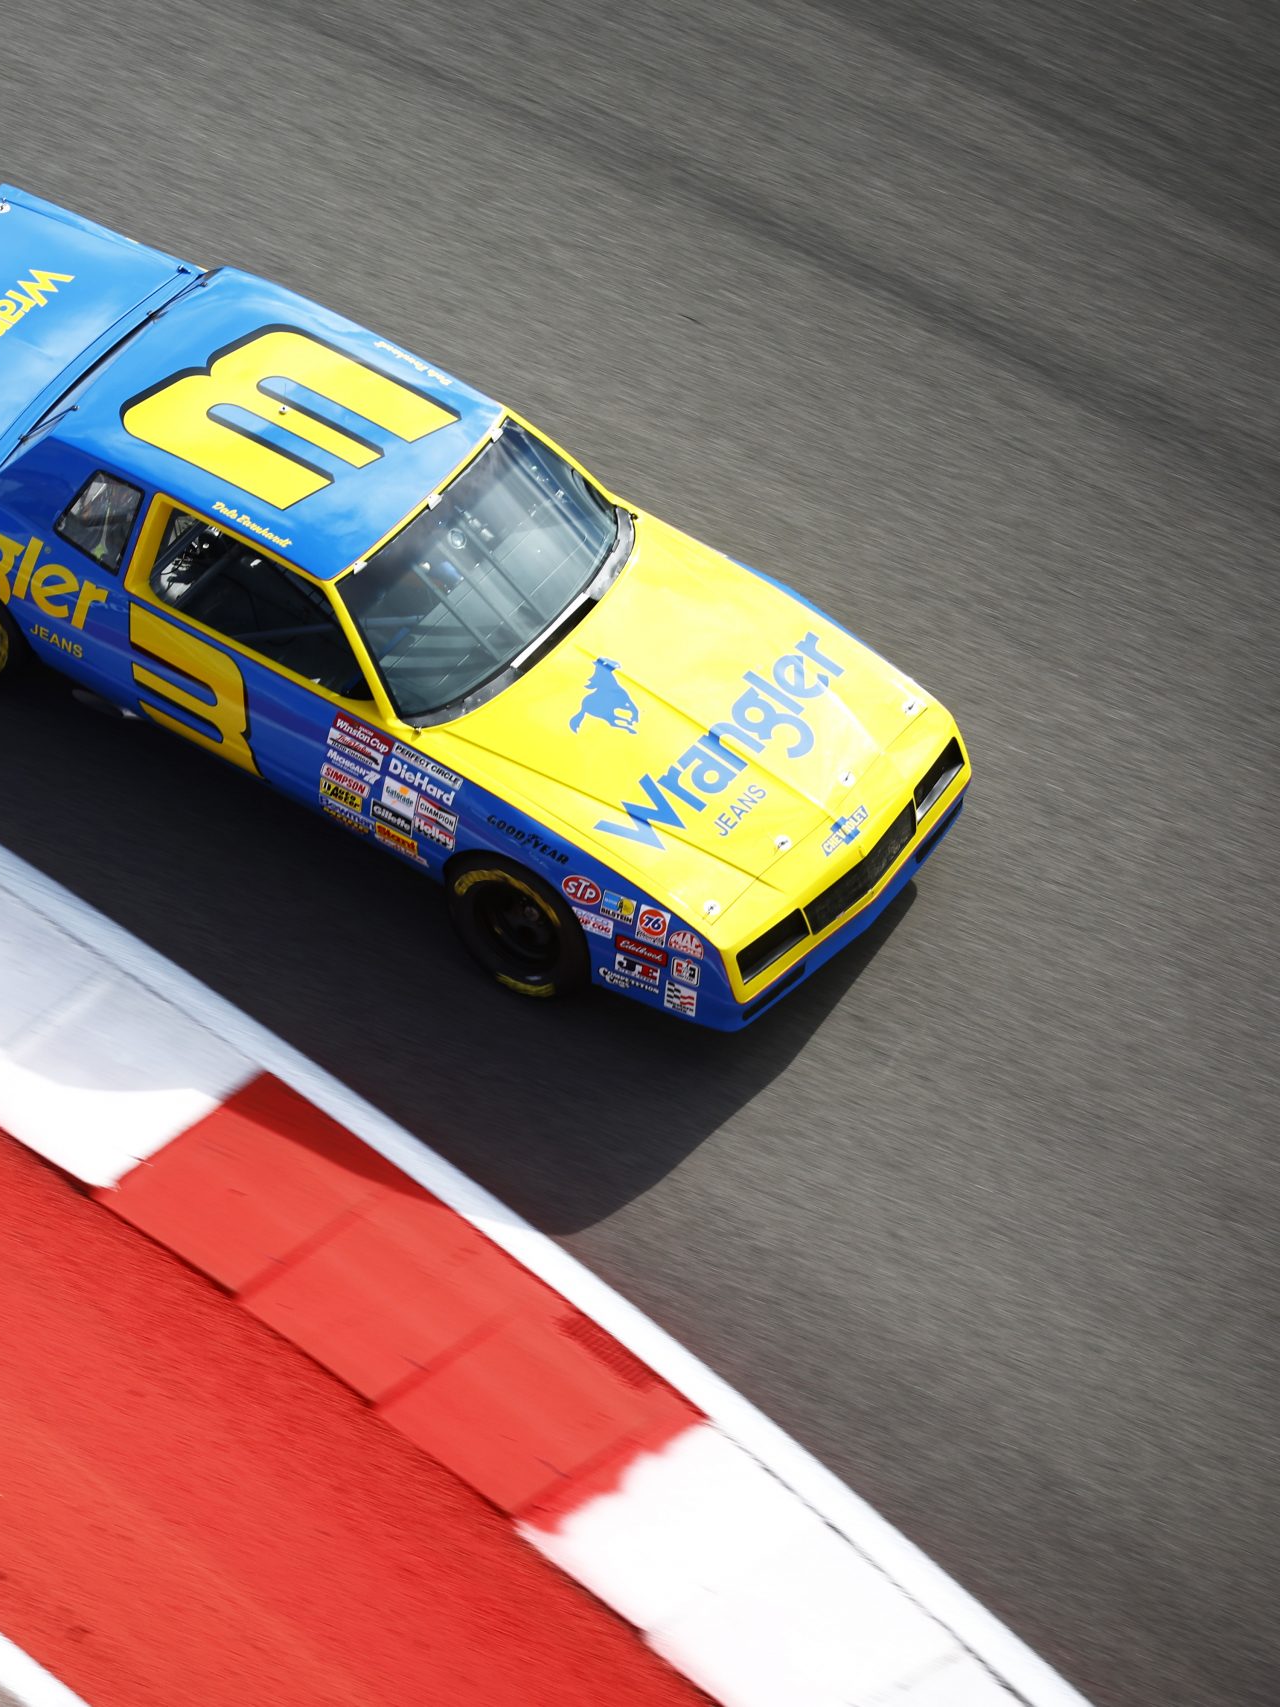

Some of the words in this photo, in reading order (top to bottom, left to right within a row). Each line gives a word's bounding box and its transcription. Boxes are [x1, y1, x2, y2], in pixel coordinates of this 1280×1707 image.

[119, 323, 462, 511] 3
[211, 501, 238, 519] Dale
[29, 623, 84, 659] JEANS
[129, 600, 266, 780] 3
[336, 718, 371, 744] Winston
[370, 738, 389, 753] Cup
[593, 631, 845, 850] Wrangler
[327, 749, 368, 777] MICHIGAN
[395, 745, 431, 769] PERFECT
[430, 762, 461, 785] CIRCLE
[324, 767, 366, 794] SIMPSON
[331, 786, 356, 802] Auto
[388, 757, 456, 806] DieHard
[385, 786, 414, 807] Gatorade
[714, 784, 767, 836] JEANS
[373, 805, 411, 831] Gillette
[419, 802, 454, 828] CHAMPION
[414, 817, 454, 850] Holley
[487, 815, 569, 865] GOODYEAR
[822, 808, 867, 853] CHEVROLET
[566, 879, 596, 900] STP
[592, 921, 611, 934] COG
[601, 907, 632, 924] BILSTEIN
[641, 914, 662, 931] 76
[619, 940, 663, 962] Edelbrock
[671, 932, 702, 951] MAC
[617, 957, 658, 981] JE
